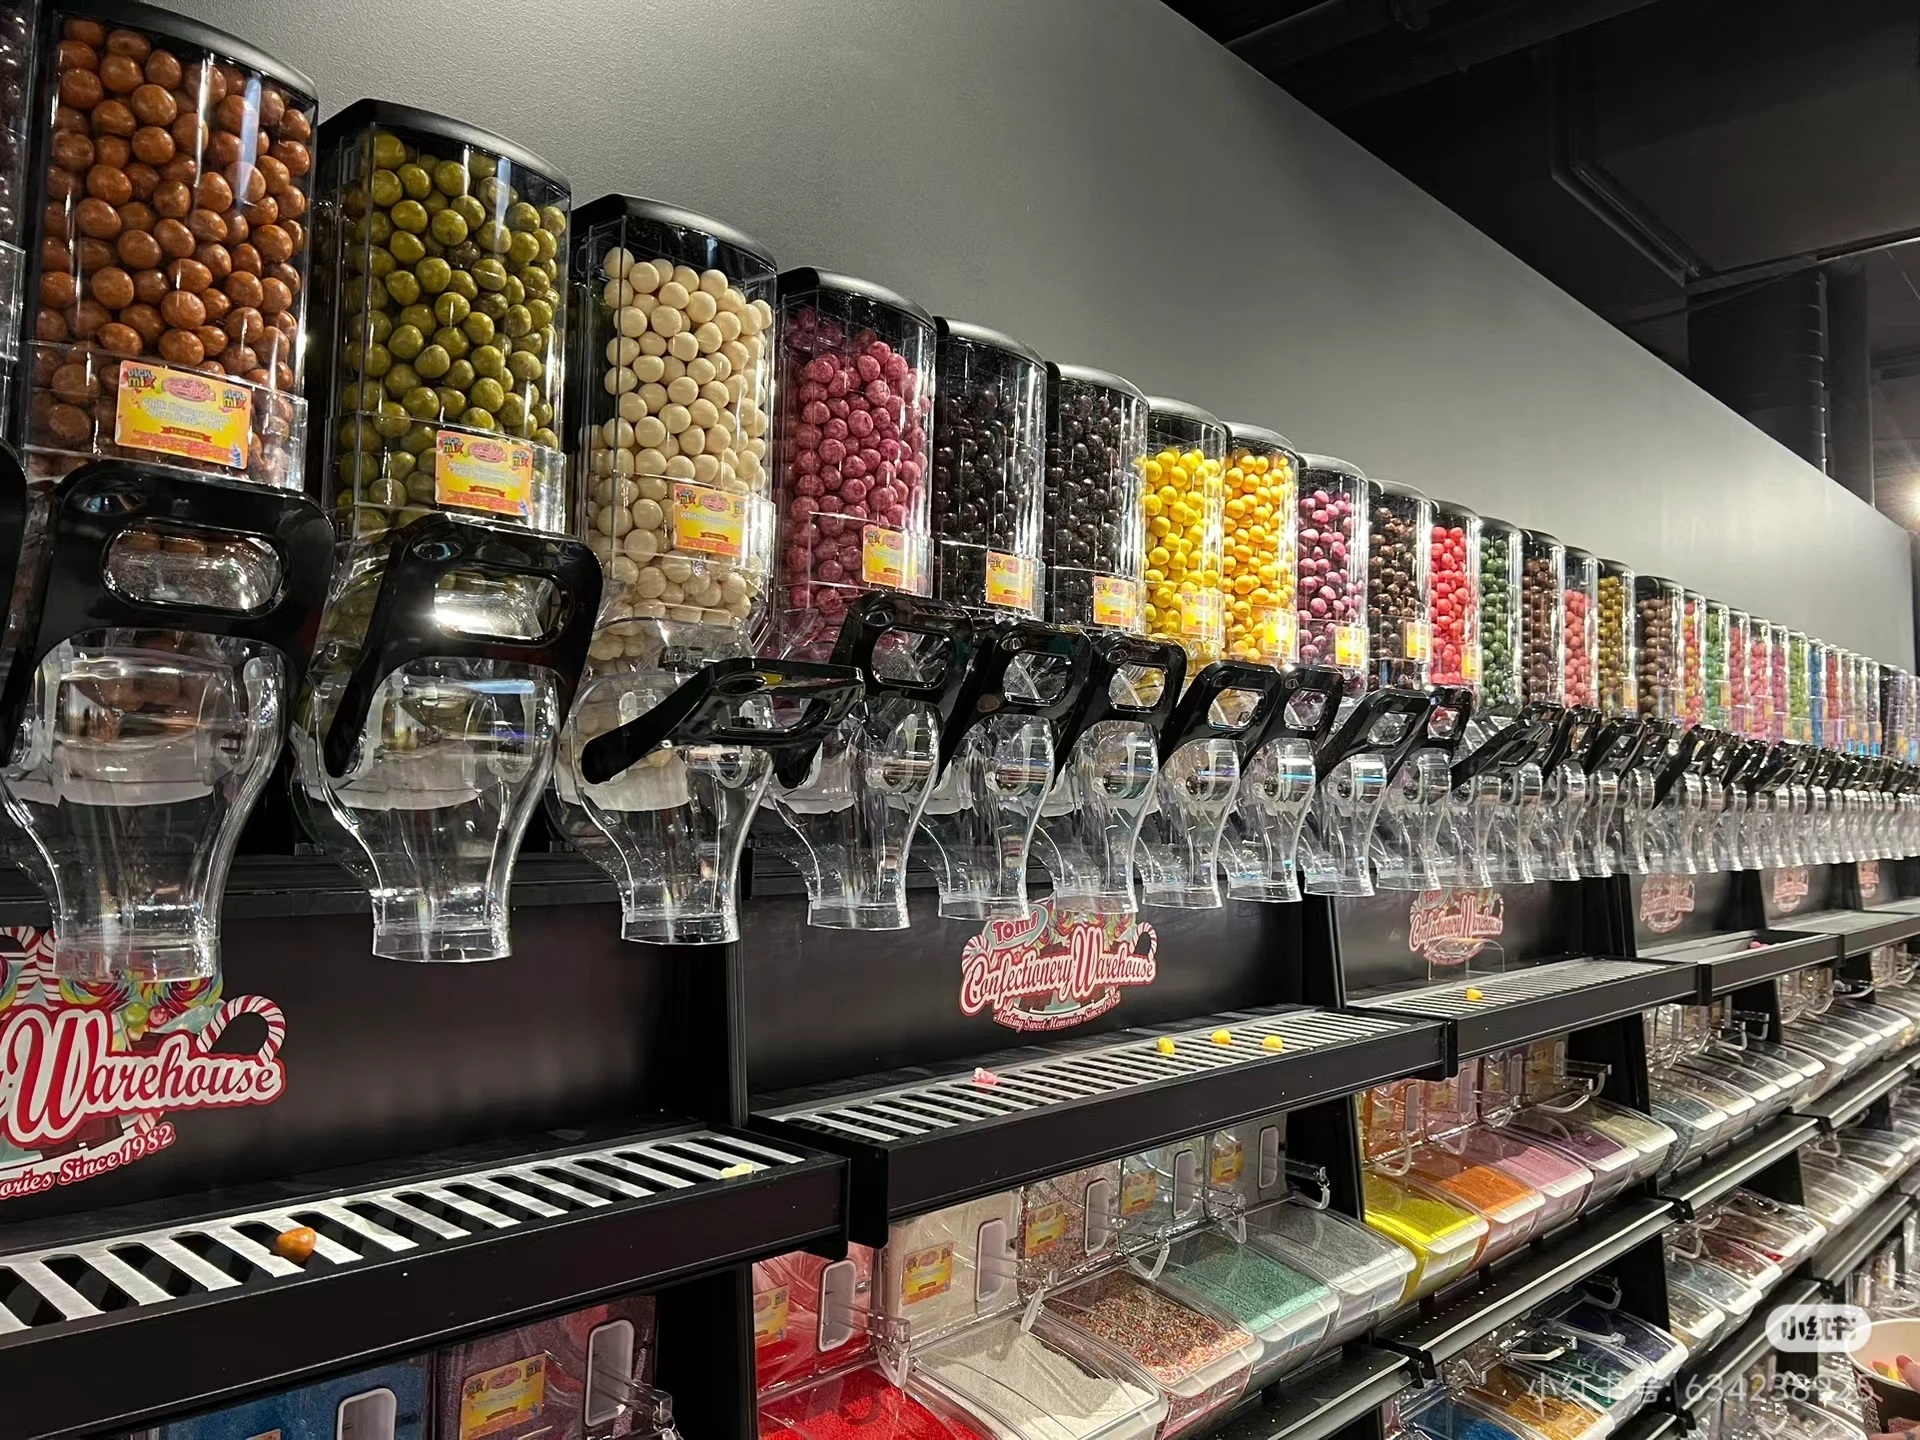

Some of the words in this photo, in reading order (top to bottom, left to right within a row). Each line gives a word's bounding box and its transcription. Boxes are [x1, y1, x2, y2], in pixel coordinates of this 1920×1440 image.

[992, 910, 1039, 944] Toms
[961, 948, 1074, 1015] Confectionery
[1070, 926, 1157, 1001] Warehouse
[993, 1010, 1025, 1033] Making
[1024, 1016, 1046, 1031] Sweet
[1046, 1012, 1082, 1030] Memories
[5, 1012, 280, 1138] Warehouse
[60, 1154, 119, 1183] Since
[121, 1125, 174, 1162] 1982
